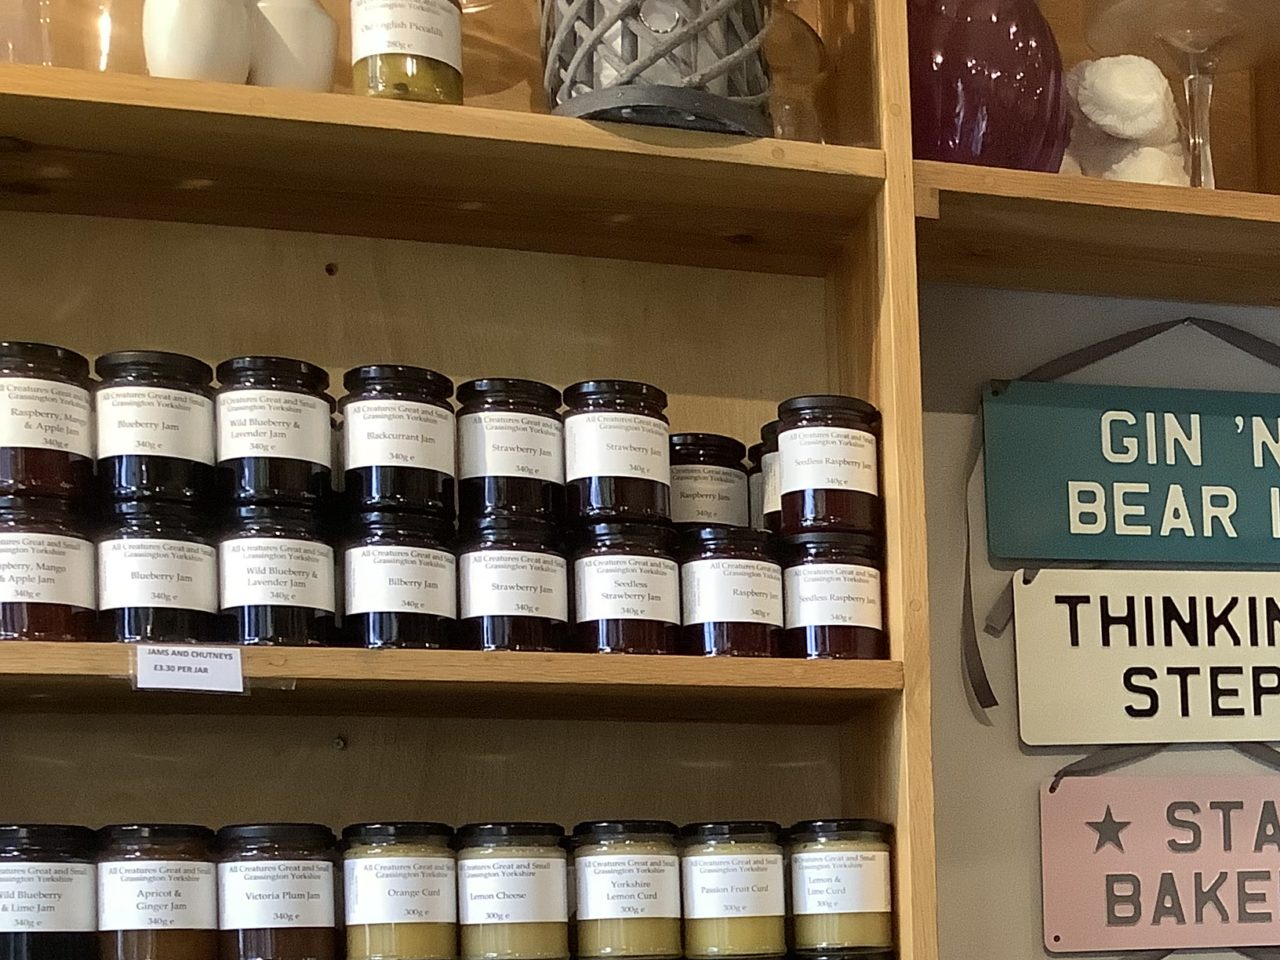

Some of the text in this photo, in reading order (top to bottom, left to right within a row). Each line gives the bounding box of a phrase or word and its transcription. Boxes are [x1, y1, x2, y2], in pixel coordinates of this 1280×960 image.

[161, 421, 179, 431] Jam
[249, 418, 291, 429] Blueberry
[269, 430, 287, 440] Jam
[366, 432, 435, 444] Blackcurrant Jam
[1100, 410, 1201, 466] GIN
[492, 443, 552, 457] Strawberry Jam
[606, 442, 649, 455] Strawberry
[825, 458, 861, 470] Raspberry
[680, 492, 717, 501] Raspberry
[1068, 481, 1238, 538] BEAR
[36, 563, 67, 573] Mango
[247, 567, 310, 579] Wild Blueberry
[38, 575, 55, 585] Jam
[131, 570, 193, 582] Blueberry Jam
[247, 578, 306, 588] Lavender Jam
[388, 578, 438, 590] Bilberry Jam
[491, 583, 553, 594] Strawberry Jam
[600, 590, 661, 603] Strawberry Jam
[733, 589, 768, 599] Raspberry
[148, 648, 233, 660] JAMS AND CHUTNEYS
[154, 664, 175, 673] £3.30
[177, 665, 192, 673] PER
[611, 881, 651, 889] Yorkshire
[701, 884, 769, 893] Passion Fruit Curd
[137, 889, 172, 899] Apricot
[245, 891, 305, 900] Victoria Plum
[388, 888, 420, 898] Orange
[470, 891, 526, 900] Lemon Cheese
[607, 891, 657, 900] Lemon Curd
[136, 902, 187, 912] Ginger Jam
